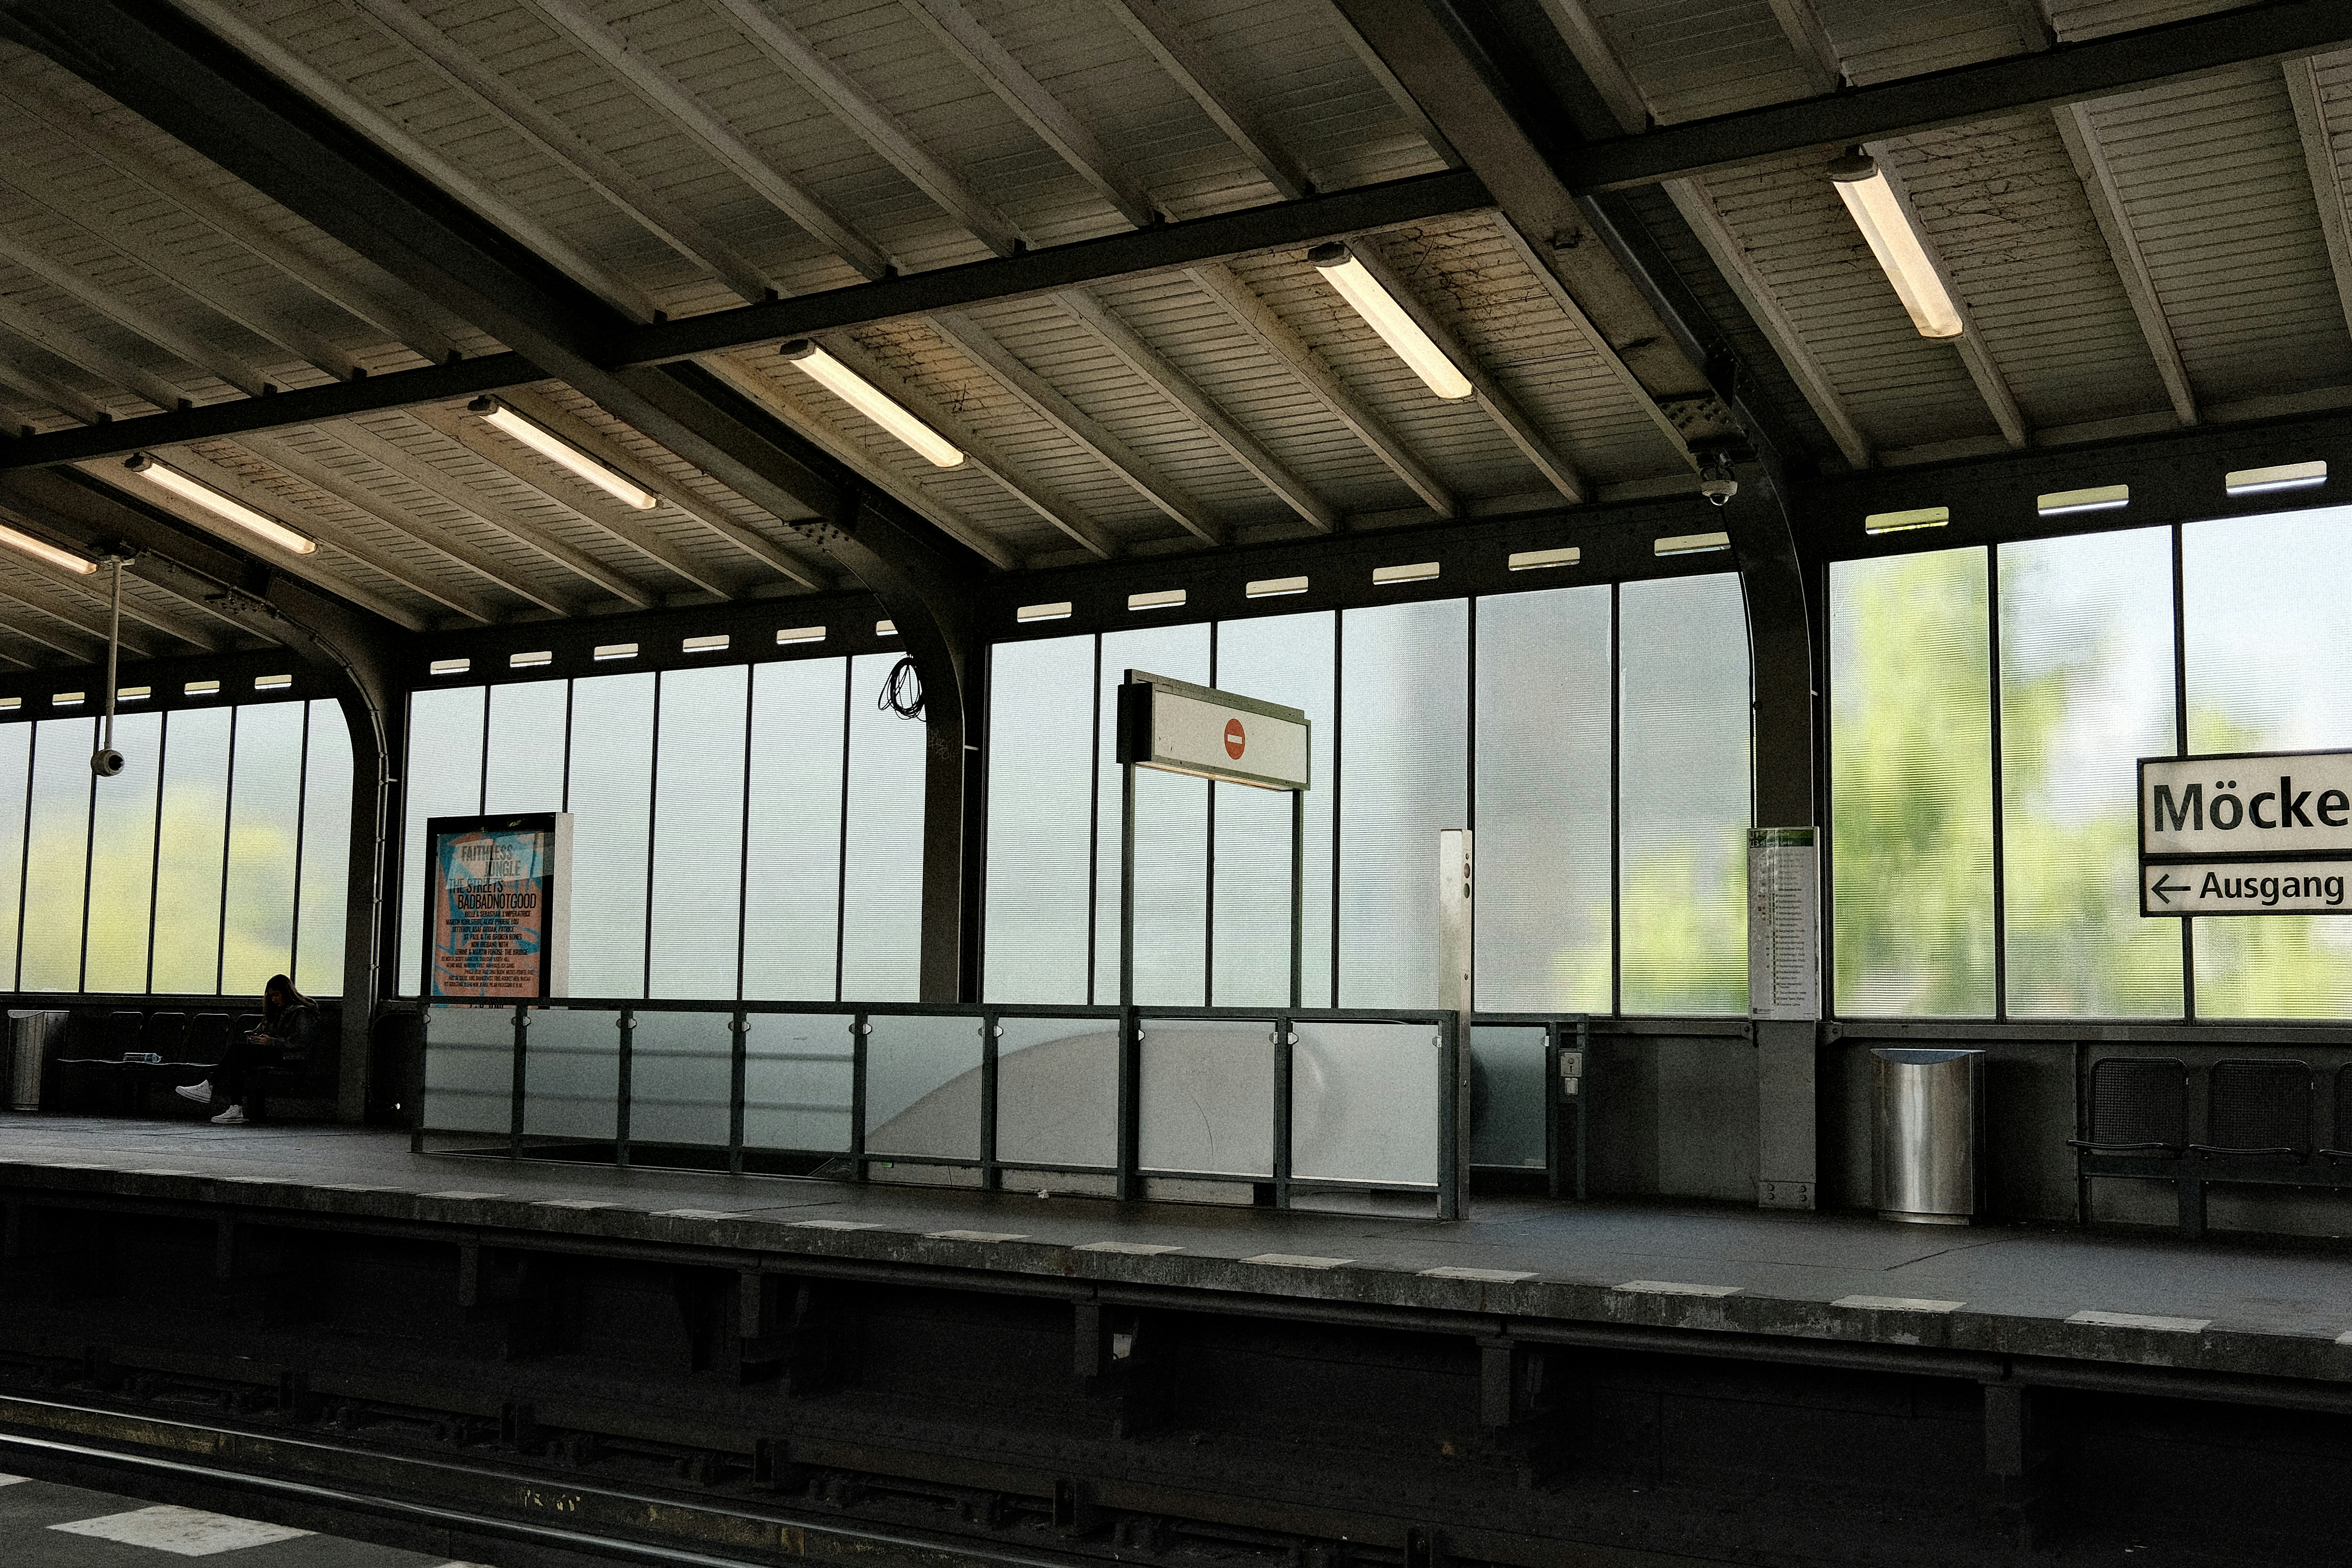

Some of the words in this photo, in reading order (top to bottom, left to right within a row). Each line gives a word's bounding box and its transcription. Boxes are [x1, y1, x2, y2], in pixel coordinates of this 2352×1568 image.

[2153, 775, 2350, 832] Möcke
[484, 860, 521, 877] JUNGLE
[449, 878, 464, 894] THE
[467, 878, 504, 893] STREETS
[2199, 872, 2344, 906] Ausgang
[458, 893, 537, 910] BADBADNOTGOOD
